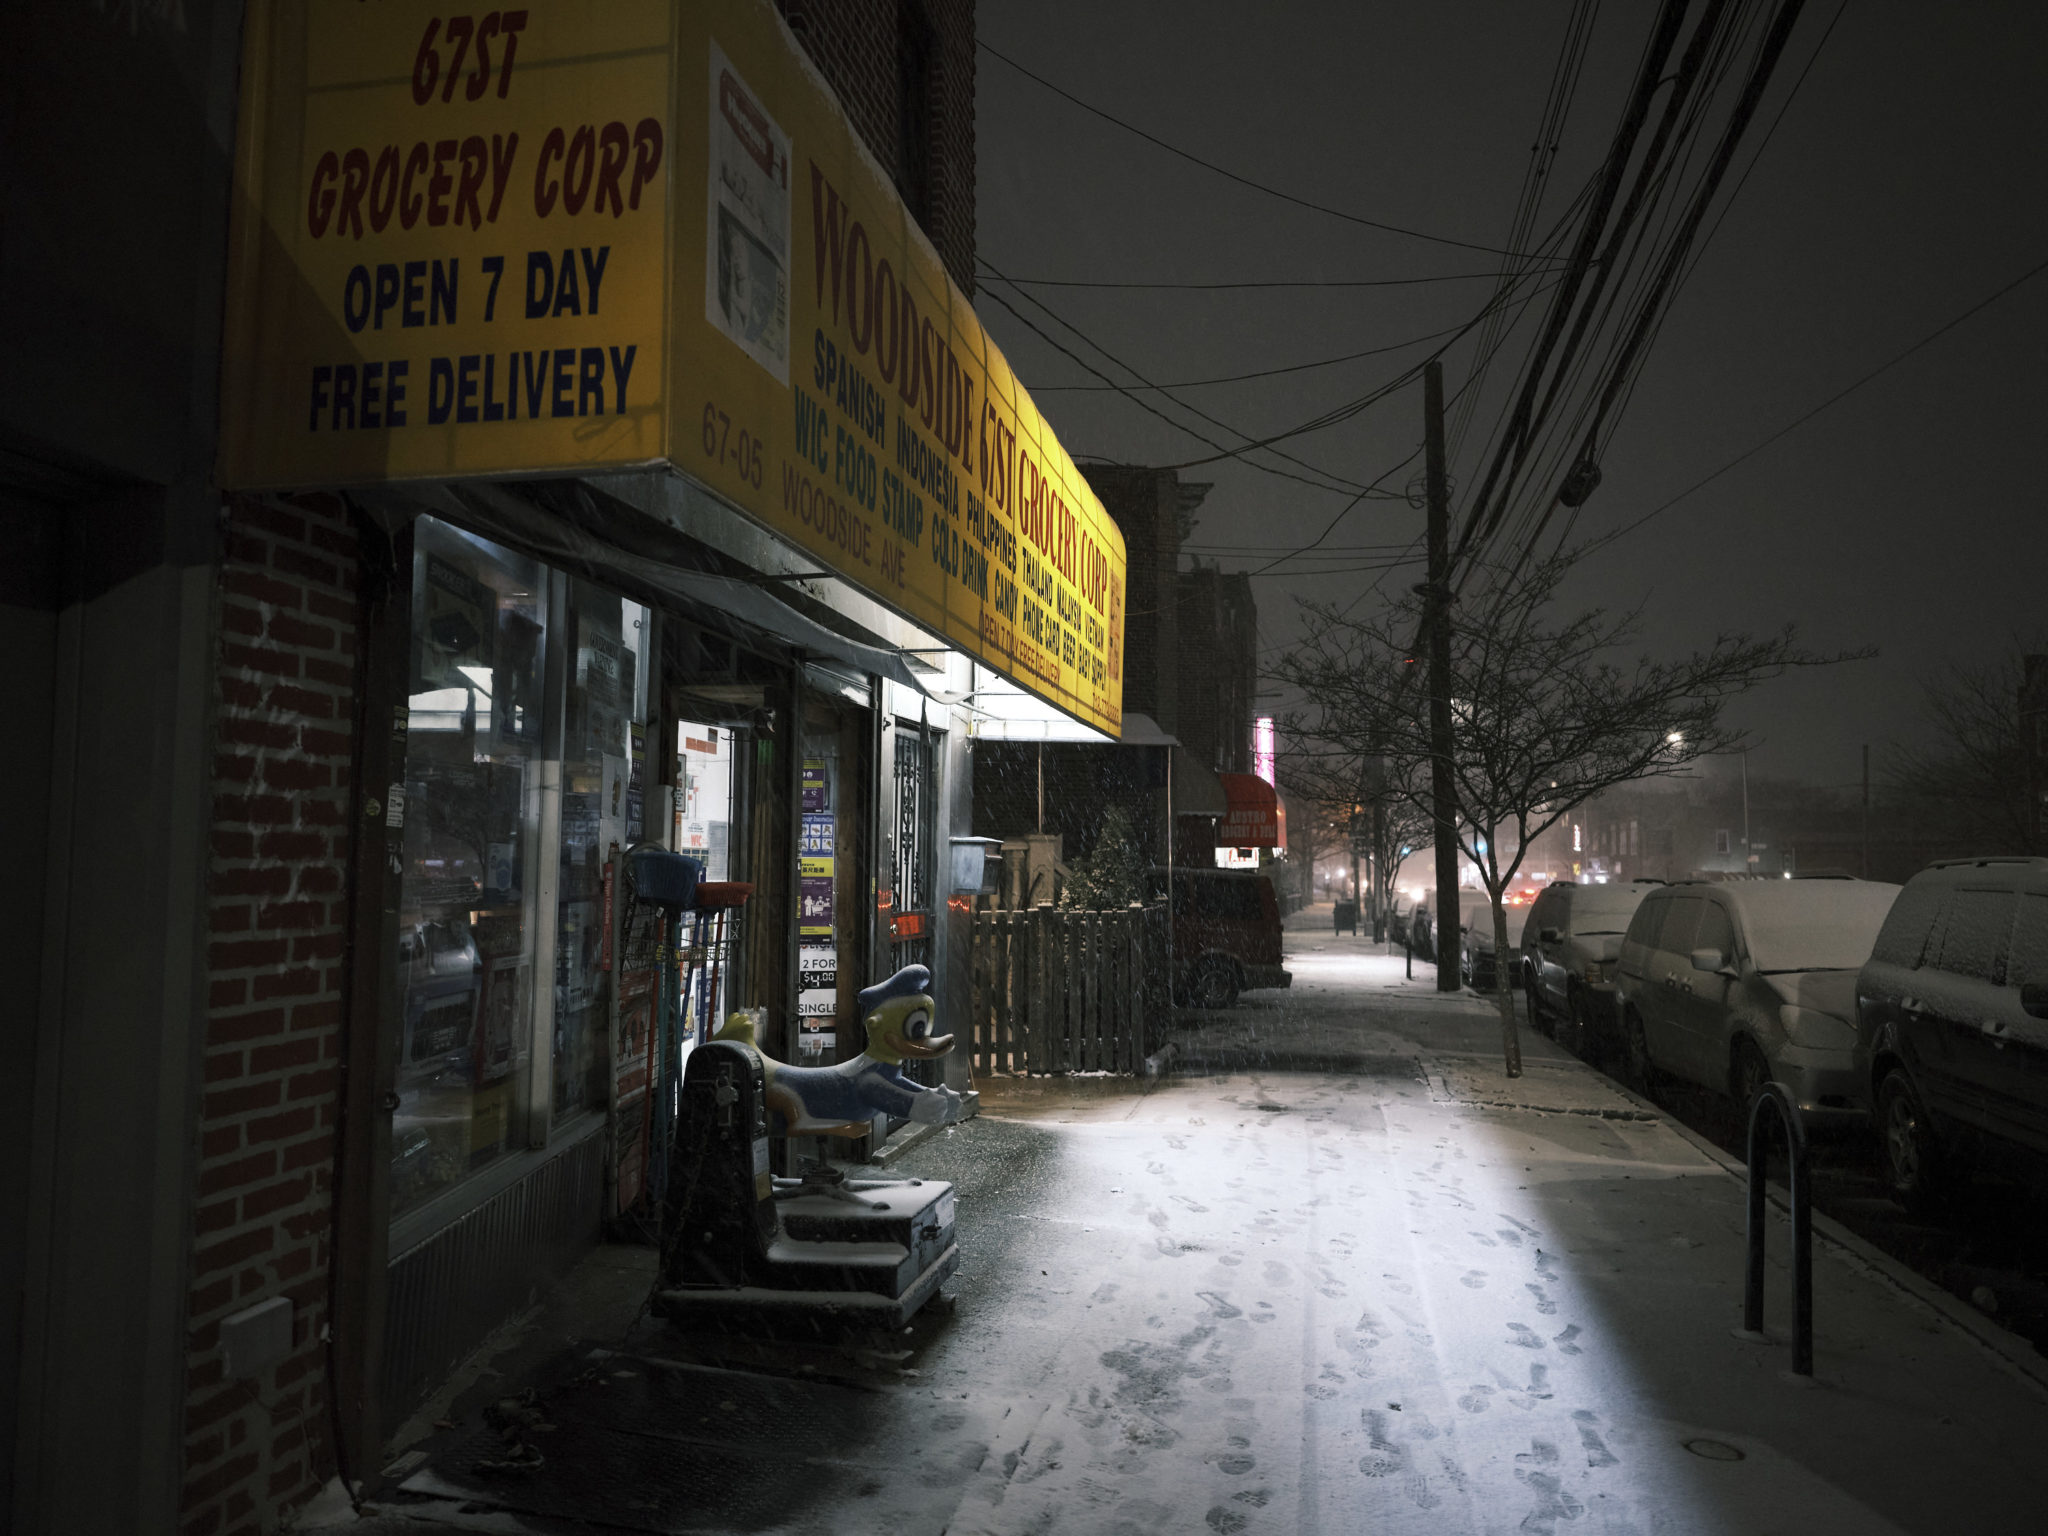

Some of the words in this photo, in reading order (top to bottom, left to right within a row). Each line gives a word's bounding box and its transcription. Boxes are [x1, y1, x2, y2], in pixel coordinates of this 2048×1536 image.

[411, 10, 529, 106] 67ST
[307, 132, 520, 241] GROCERY
[533, 117, 664, 219] CORP
[343, 258, 460, 334] OPEN
[481, 255, 505, 323] 7
[524, 246, 611, 320] DAY
[308, 360, 409, 432] FREE
[427, 345, 638, 426] DELIVERY
[809, 157, 975, 476] WOODSIDE
[979, 398, 1016, 520] 67ST
[1018, 449, 1080, 588] GROCERY
[1080, 528, 1108, 616] CORP
[702, 401, 763, 491] 67-05
[782, 459, 872, 568] WOODSIDE
[879, 537, 906, 590] AVE
[794, 383, 828, 475] WIC
[836, 424, 877, 513] FOOD
[882, 467, 923, 549] STAMP
[931, 511, 959, 578] COLD
[962, 538, 989, 604] DRINK
[994, 568, 1019, 626] CANDY
[1022, 594, 1044, 646] PHONE
[1045, 613, 1060, 657] CARD
[1062, 629, 1076, 670] BEER
[1078, 642, 1091, 681] BABY
[813, 327, 886, 449] SPANISH
[896, 416, 959, 521] INDONESIA
[966, 489, 1017, 575] PHILIPPINES
[1022, 546, 1053, 607] THAILAND
[1057, 582, 1082, 635] MALAYSIA
[1084, 610, 1105, 654] VIETNAM
[978, 609, 1000, 652] OPEN
[1006, 630, 1020, 663] DAY
[1019, 639, 1035, 671] FREE
[1035, 651, 1061, 688] DELIVERY
[798, 1003, 837, 1014] SINGLE
[802, 960, 809, 969] 2
[812, 959, 836, 969] FOR
[803, 971, 835, 988] $4.00
